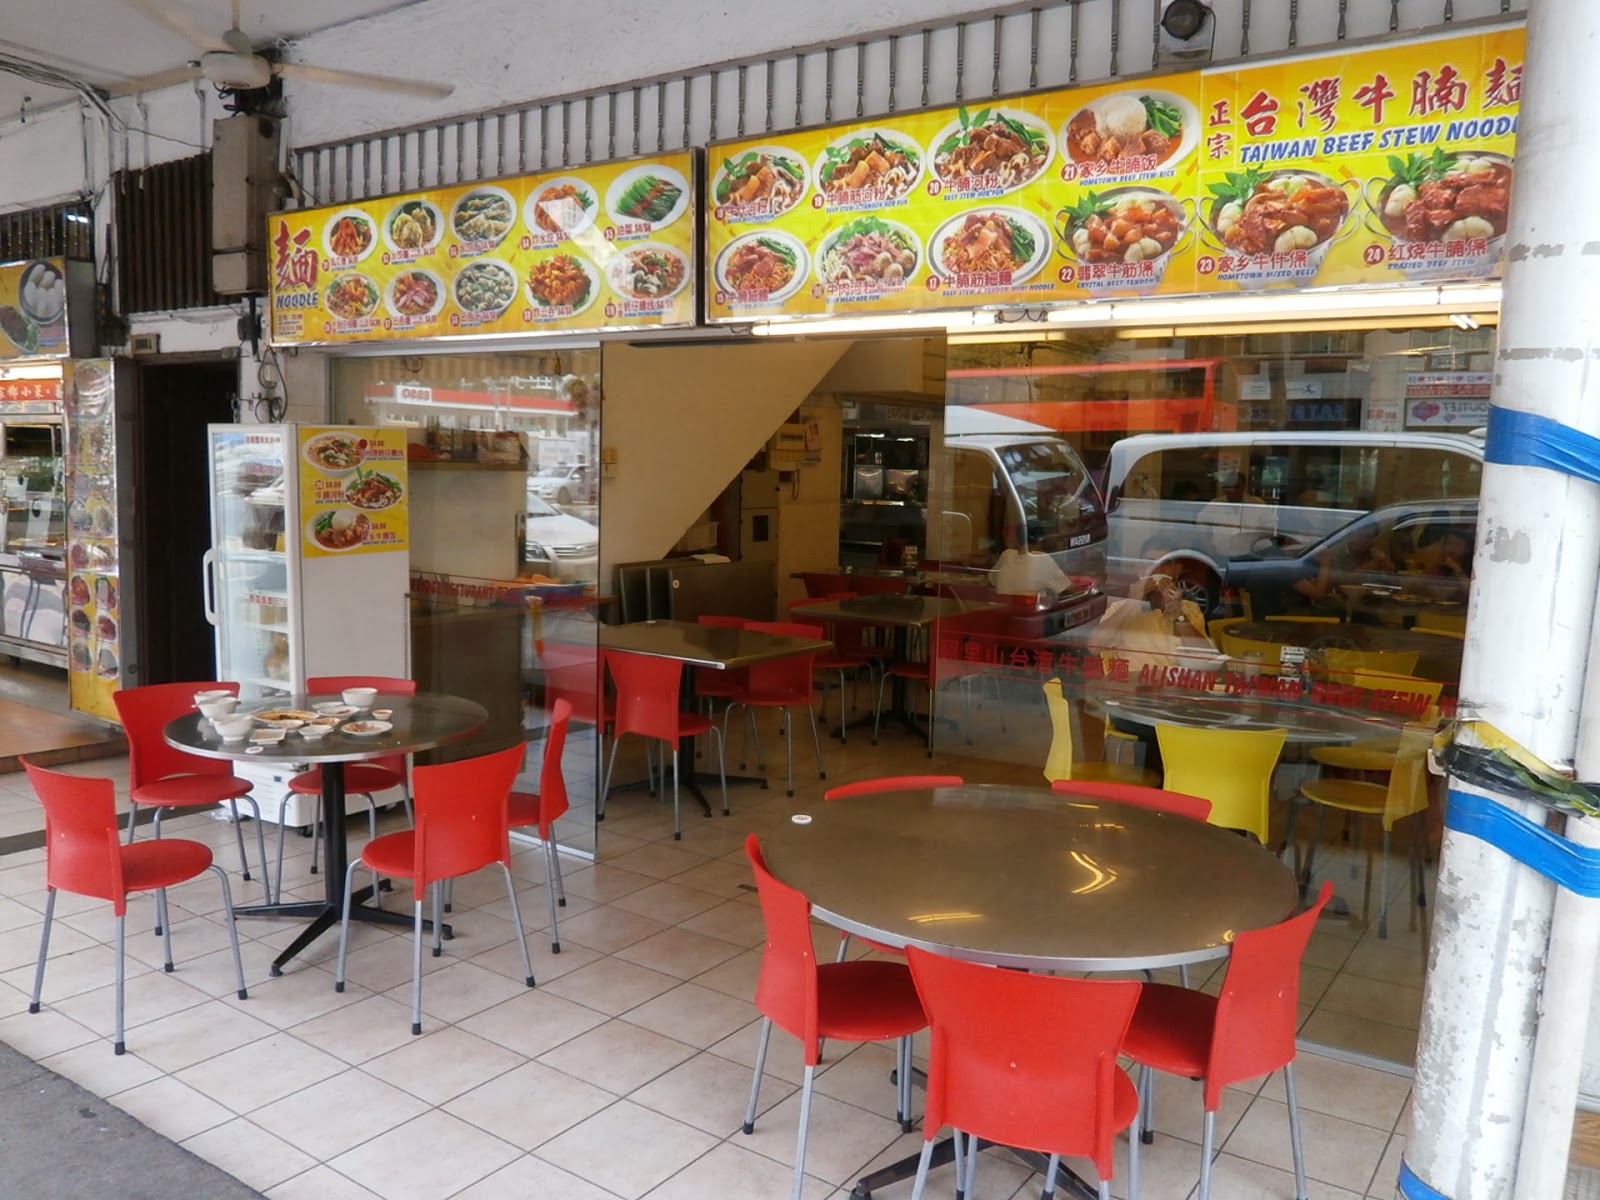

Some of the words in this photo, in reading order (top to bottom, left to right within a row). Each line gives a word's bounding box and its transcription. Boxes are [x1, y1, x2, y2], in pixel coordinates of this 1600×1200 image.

[1207, 100, 1232, 160] 正宗
[1240, 138, 1316, 164] TAIWAN
[1322, 131, 1374, 155] BEEF
[1378, 123, 1442, 147] STEW
[1064, 166, 1077, 180] 21
[1079, 155, 1158, 179] 家乡牛腩饭
[1079, 175, 1117, 186] HOMETOWN
[1119, 173, 1136, 182] BEEF
[1138, 171, 1156, 180] STEW
[1159, 169, 1175, 178] RICE
[928, 180, 941, 195] 20
[1366, 247, 1382, 262] 24
[1199, 259, 1213, 273] 23
[1426, 259, 1448, 268] BEEF
[1452, 258, 1476, 266] STEW
[1060, 267, 1073, 281] 22
[1217, 269, 1263, 281] HOMETOWN
[1266, 268, 1292, 279] MIXED
[1295, 267, 1316, 276] BEEF
[929, 276, 938, 290] 17
[1030, 283, 1055, 291] NOODLE
[1077, 280, 1105, 289] CRYSTAL
[1106, 279, 1124, 287] BEEF
[1126, 277, 1155, 286] TENDON
[276, 292, 319, 309] NOODLE
[1138, 663, 1217, 692] ALISHAN
[1367, 688, 1432, 717] STEW
